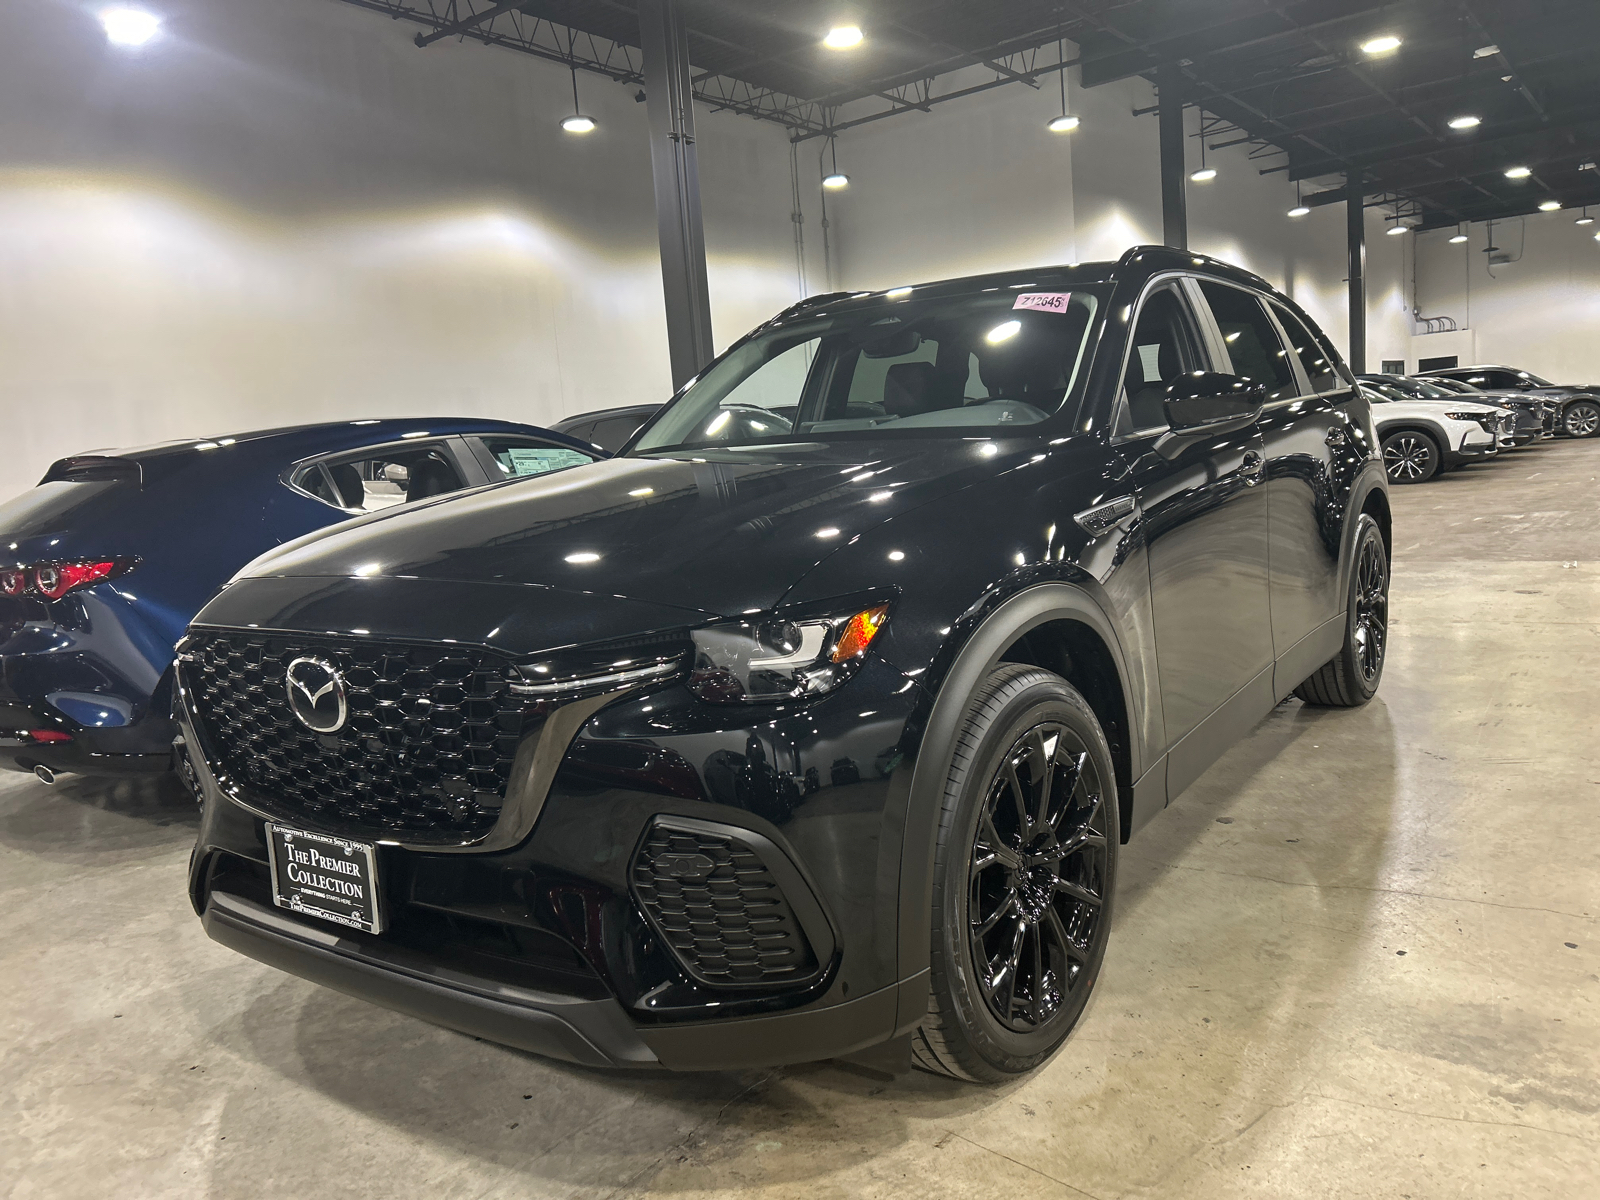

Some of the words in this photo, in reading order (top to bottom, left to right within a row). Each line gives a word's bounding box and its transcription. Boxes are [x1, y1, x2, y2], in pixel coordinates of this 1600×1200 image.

[272, 825, 303, 837] AUTOMOTIVE
[303, 831, 333, 843] EXCELLENCE
[333, 838, 349, 847] SINCE
[349, 841, 364, 851] 1995
[284, 843, 310, 865] THE
[309, 848, 361, 878] PREMIER
[287, 862, 363, 899] COLLECTION
[300, 887, 325, 898] EVERYTHING
[325, 893, 341, 903] STARTS
